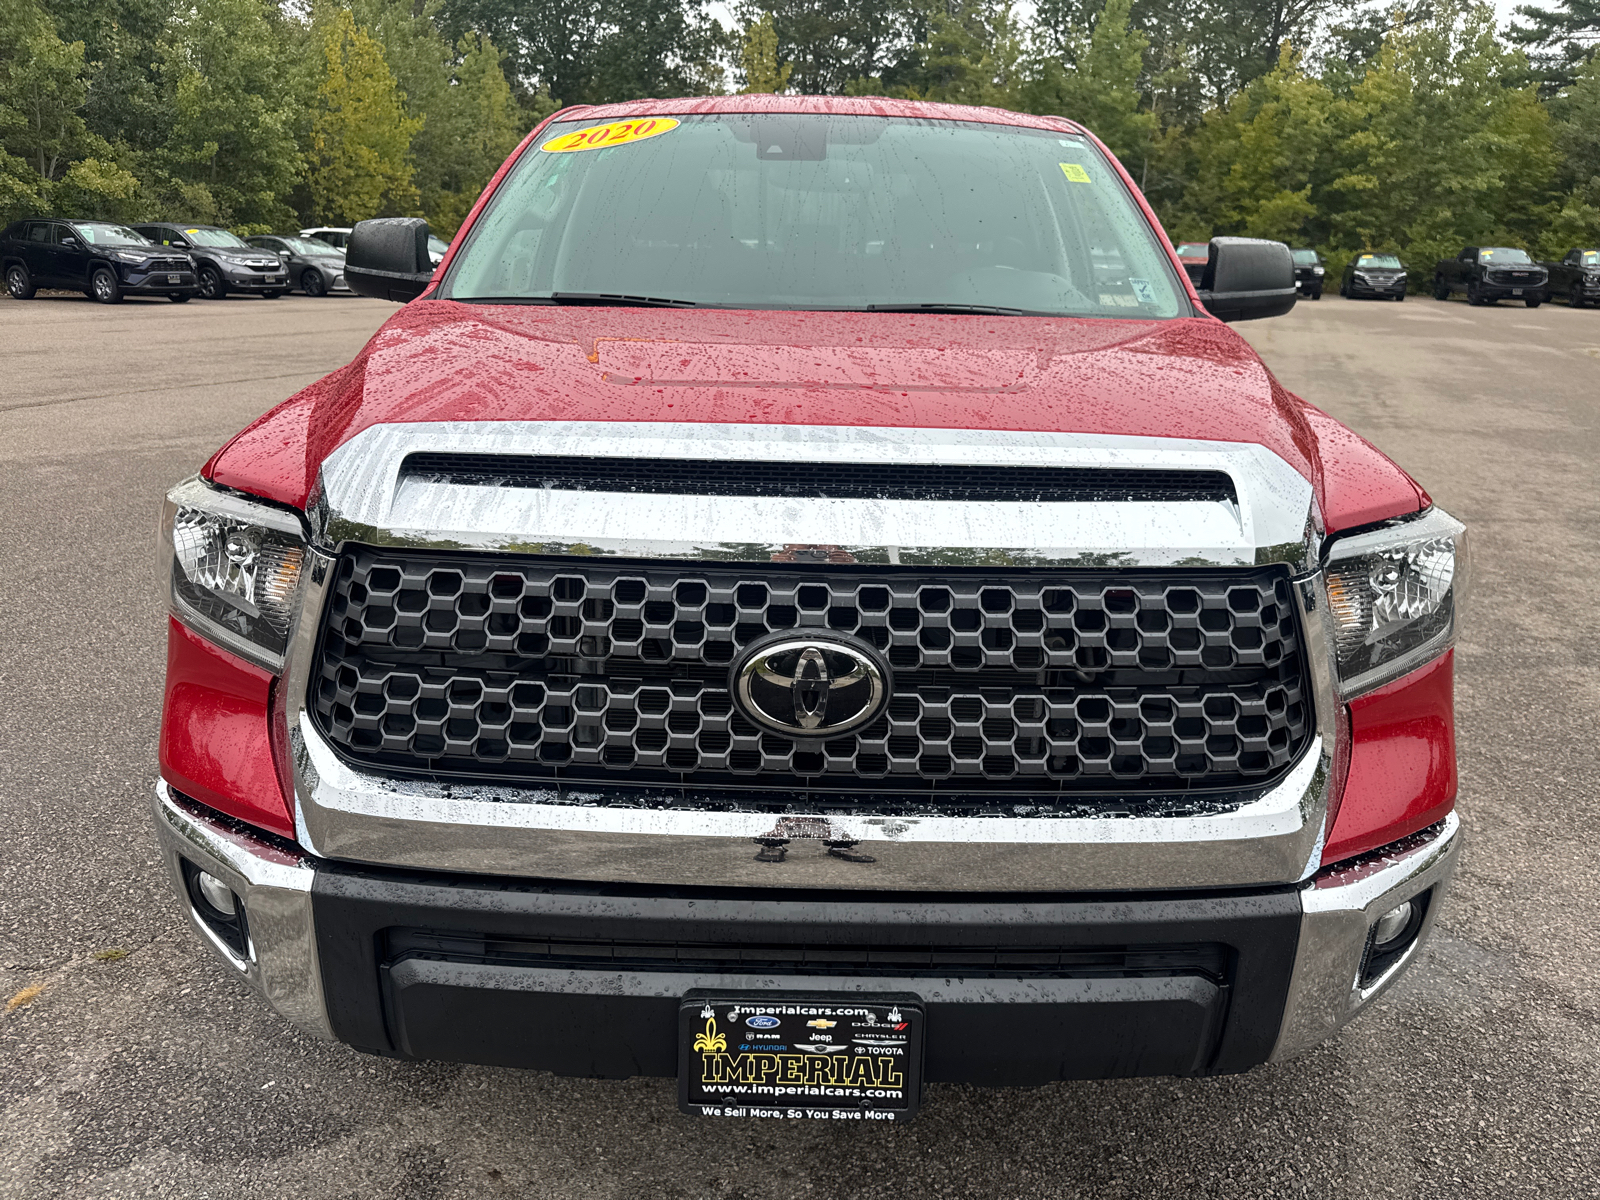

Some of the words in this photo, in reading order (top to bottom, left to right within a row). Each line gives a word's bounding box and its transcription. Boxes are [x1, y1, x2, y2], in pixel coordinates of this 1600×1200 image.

[562, 120, 657, 149] 2020
[734, 1005, 869, 1016] Imperialcars.com
[809, 1033, 832, 1042] Jeep
[867, 1046, 904, 1055] TOYOTA
[702, 1053, 903, 1088] IMPERIAL
[702, 1084, 903, 1098] www.imperialcars.com
[702, 1107, 721, 1116] We
[724, 1107, 746, 1117] Sell
[750, 1108, 784, 1119] More,
[787, 1109, 802, 1118] So
[806, 1109, 829, 1119] You
[832, 1110, 861, 1119] Save
[865, 1111, 895, 1120] More
